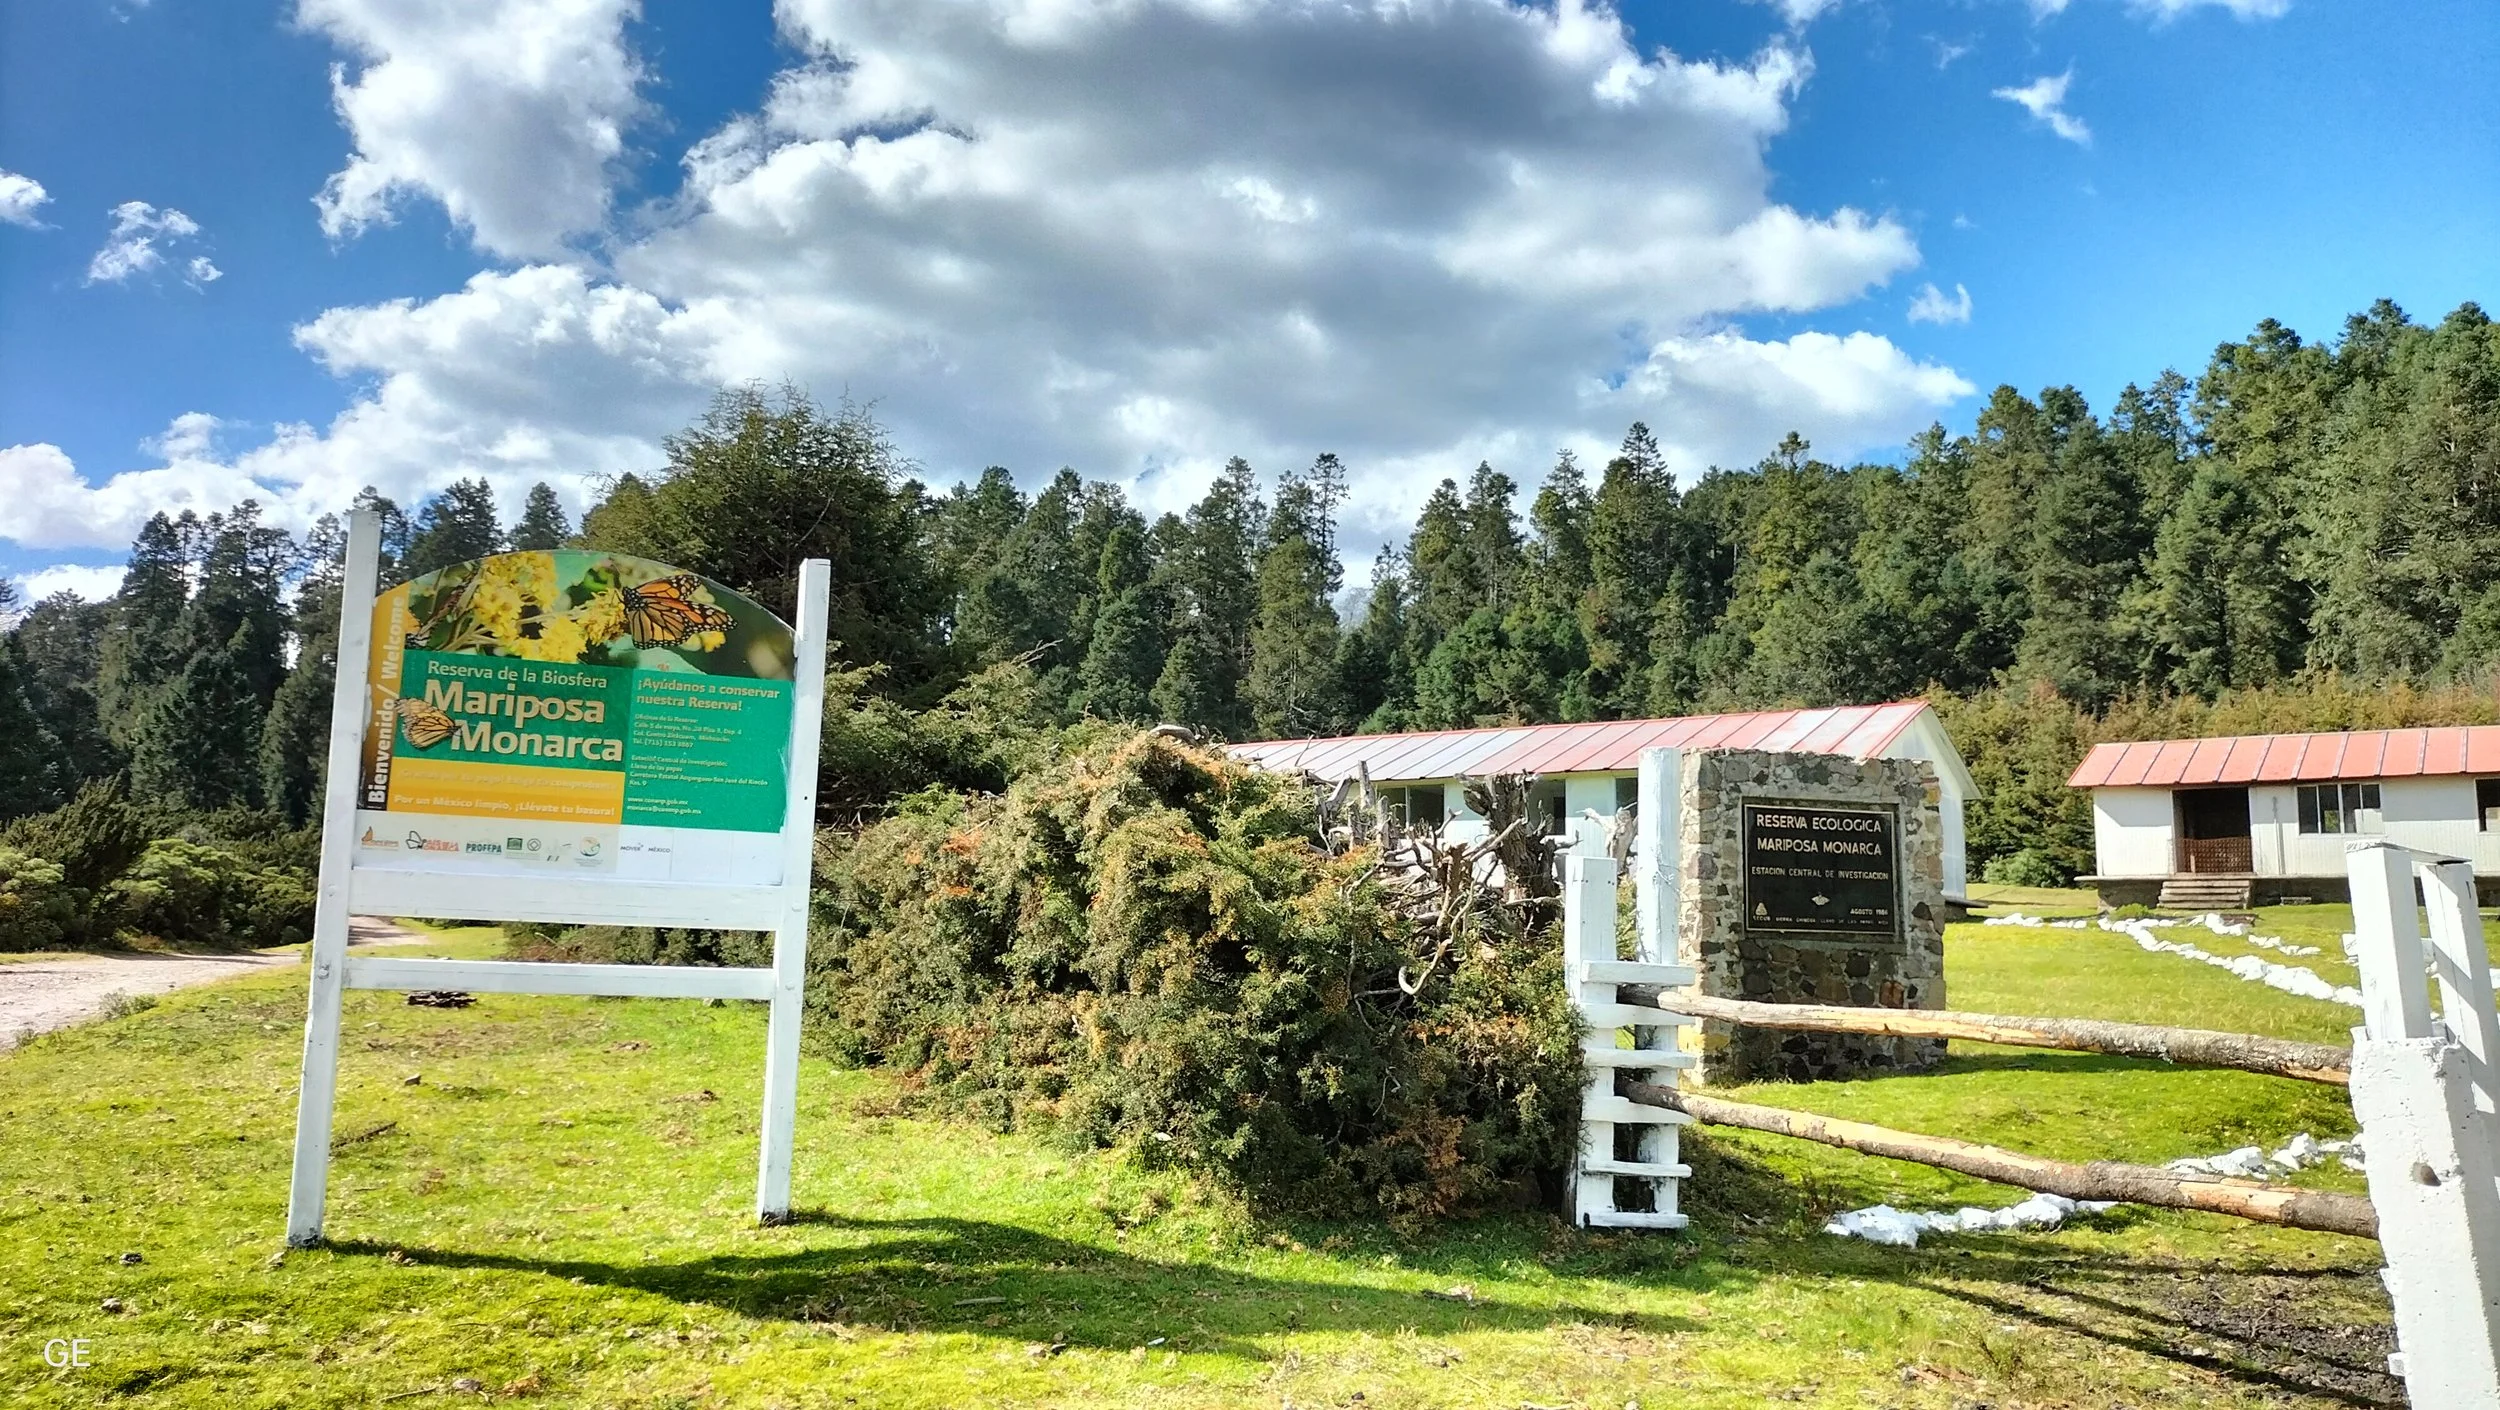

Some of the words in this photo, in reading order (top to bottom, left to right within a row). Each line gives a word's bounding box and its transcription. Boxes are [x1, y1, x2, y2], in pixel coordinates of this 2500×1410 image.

[381, 596, 405, 679] Welcome
[428, 660, 493, 679] Reserva
[497, 666, 518, 681] de
[523, 668, 536, 682] la
[542, 670, 607, 688] Biosfera
[638, 677, 705, 693] ¡Ayúdanos
[709, 685, 716, 693] a
[719, 686, 780, 699] conservar
[424, 679, 605, 728] Mariposa
[636, 694, 685, 707] nuestra
[689, 696, 742, 711] Reserva!
[451, 719, 623, 761] Monarca
[394, 794, 413, 803] Por
[432, 796, 472, 807] México
[475, 800, 512, 811] limpio,
[575, 805, 615, 816] basura!
[1756, 814, 1808, 829] RESERVA
[1812, 817, 1882, 833] ECOLOGICA
[465, 842, 502, 854] PROFEPA
[1757, 838, 1819, 853] MARIPOSA
[1823, 841, 1882, 856] MONARCA
[1751, 866, 1786, 876] ESTACION
[1788, 868, 1822, 878] CENTRAL
[1825, 870, 1835, 878] DE
[1838, 870, 1889, 880] INVESTIGACION
